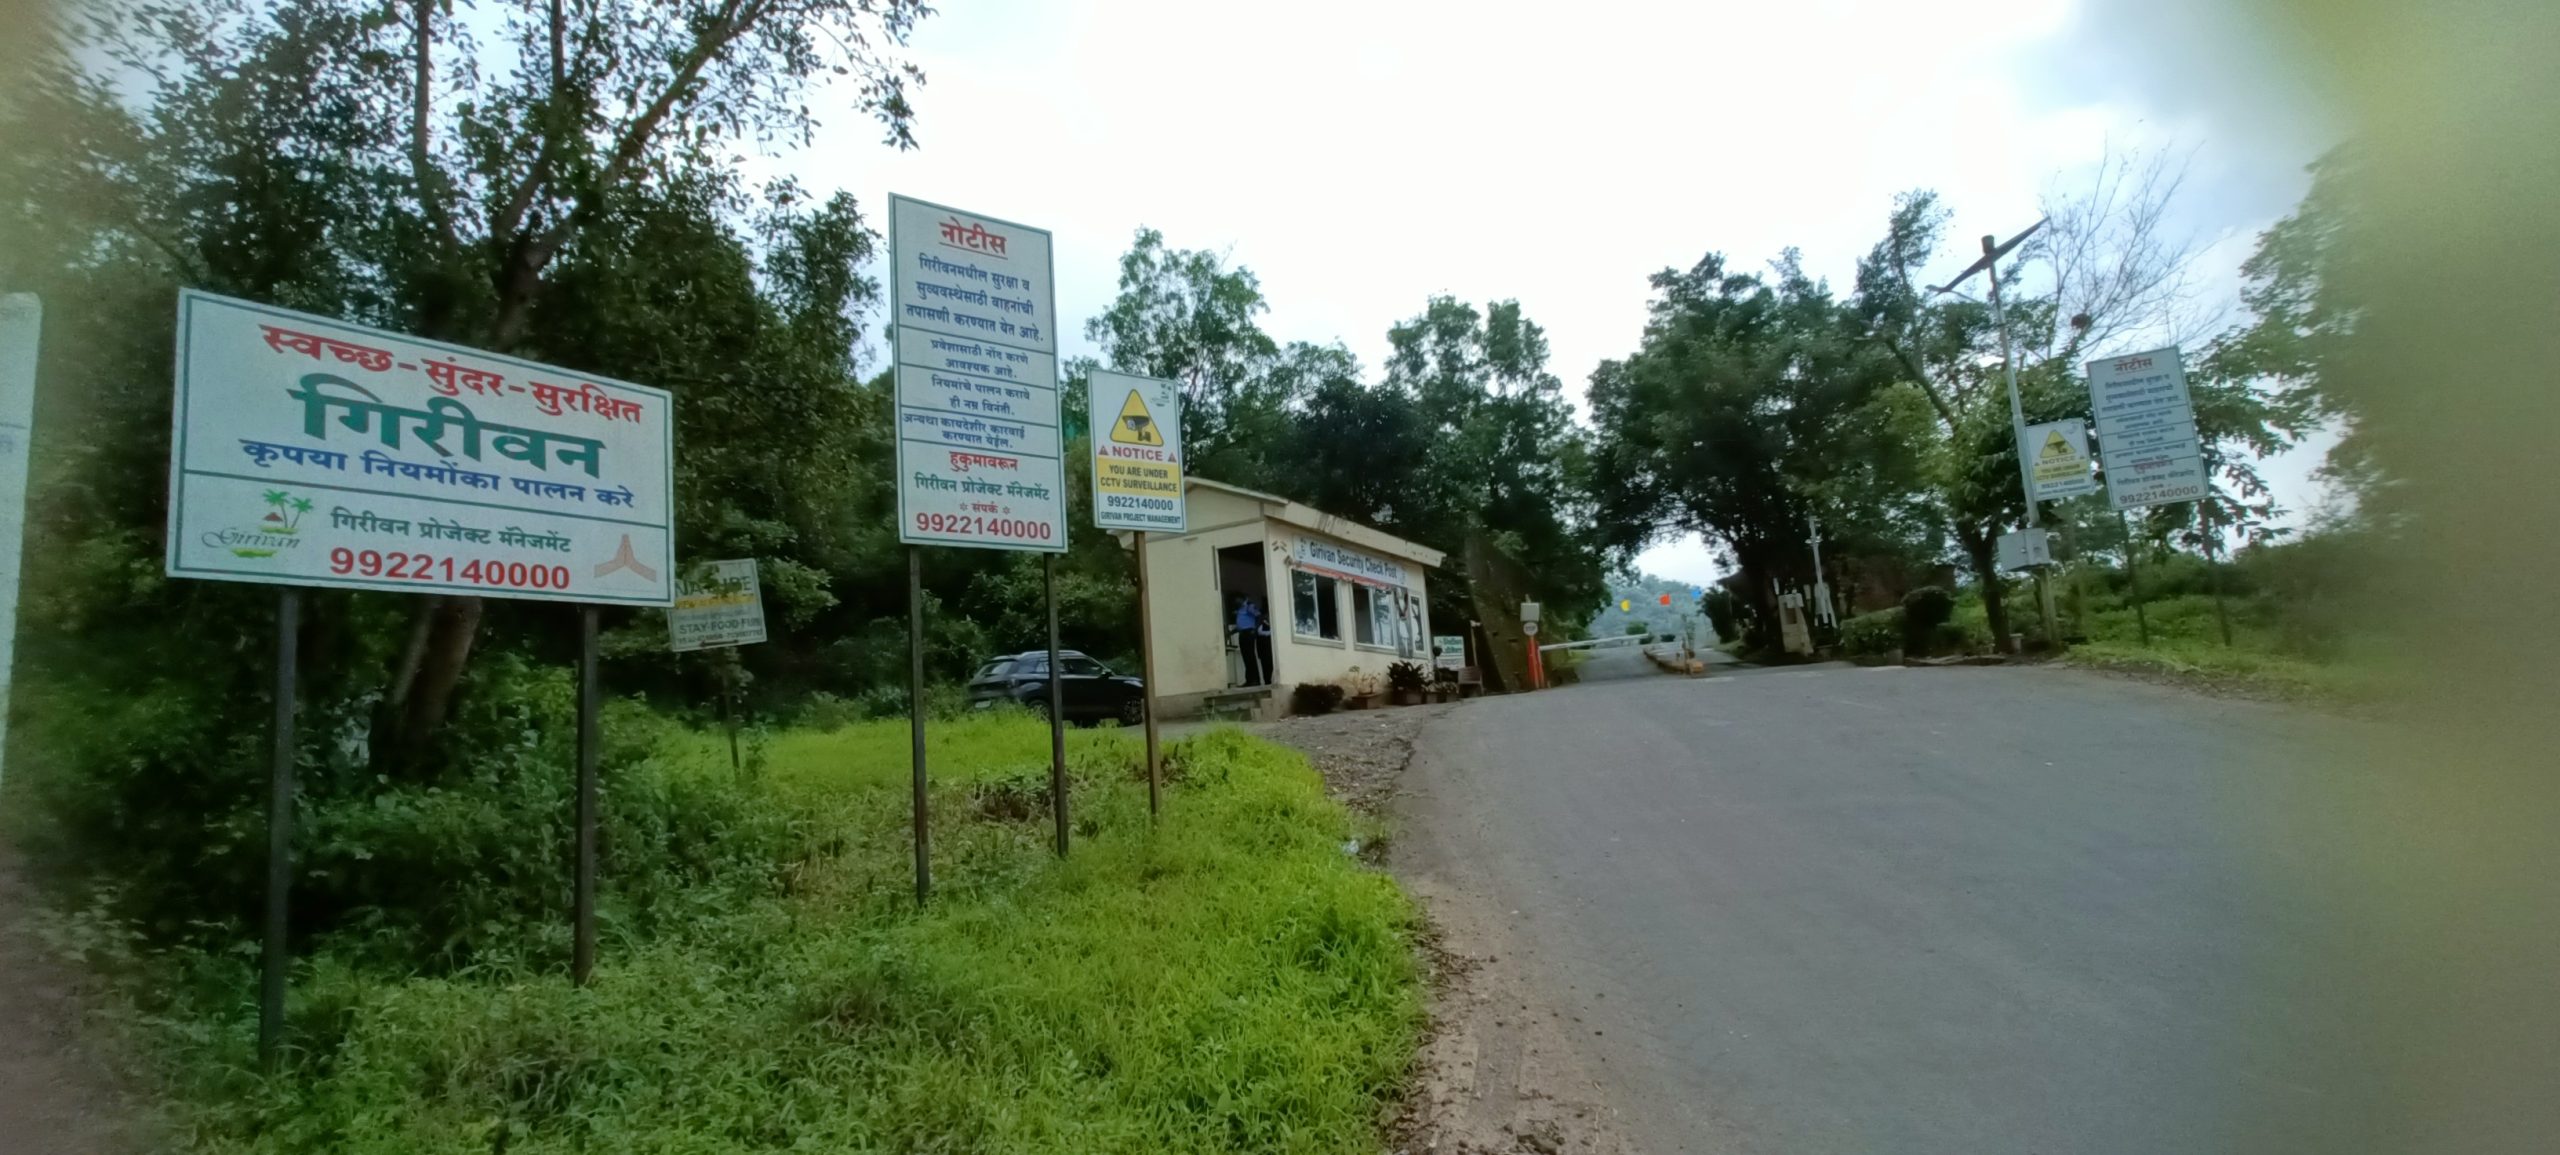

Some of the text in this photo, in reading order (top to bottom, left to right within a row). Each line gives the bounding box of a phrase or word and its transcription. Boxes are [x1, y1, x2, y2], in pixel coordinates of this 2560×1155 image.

[939, 216, 1007, 254] नोटीस
[919, 253, 1030, 291] गिरीवनमधील सुरक्षा व
[916, 281, 1034, 317] सुव्यवस्थेसाठी वाहनांची
[905, 303, 950, 324] तपासणी
[953, 312, 996, 331] करण्यात
[1000, 318, 1015, 336] येत
[931, 338, 982, 356] प्रवेशासाठी
[945, 358, 990, 374] आवश्यक
[931, 374, 972, 391] नियमांचे
[975, 384, 1002, 396] पालन
[950, 396, 960, 409] ही
[287, 373, 606, 479] गिरीवन
[949, 451, 1018, 472] हुकुमावरून
[1112, 446, 1163, 461] NOTICE
[239, 439, 635, 509] कृपया नियमोंका पालन करे
[1109, 464, 1168, 479] YOU ARE UNDER
[914, 472, 957, 493] गिरीवन
[961, 476, 1003, 496] प्रोजेक्ट
[1101, 477, 1177, 492] CCTV SURVEILLANCE
[2120, 485, 2198, 504] 9922140000
[1107, 496, 1173, 511] 9922140000
[330, 506, 410, 536] गिरीवन
[417, 517, 492, 545] प्रोजेक्ट
[916, 512, 1051, 540] 9922140000
[330, 547, 571, 590] 9922140000
[1337, 549, 1364, 574] Security
